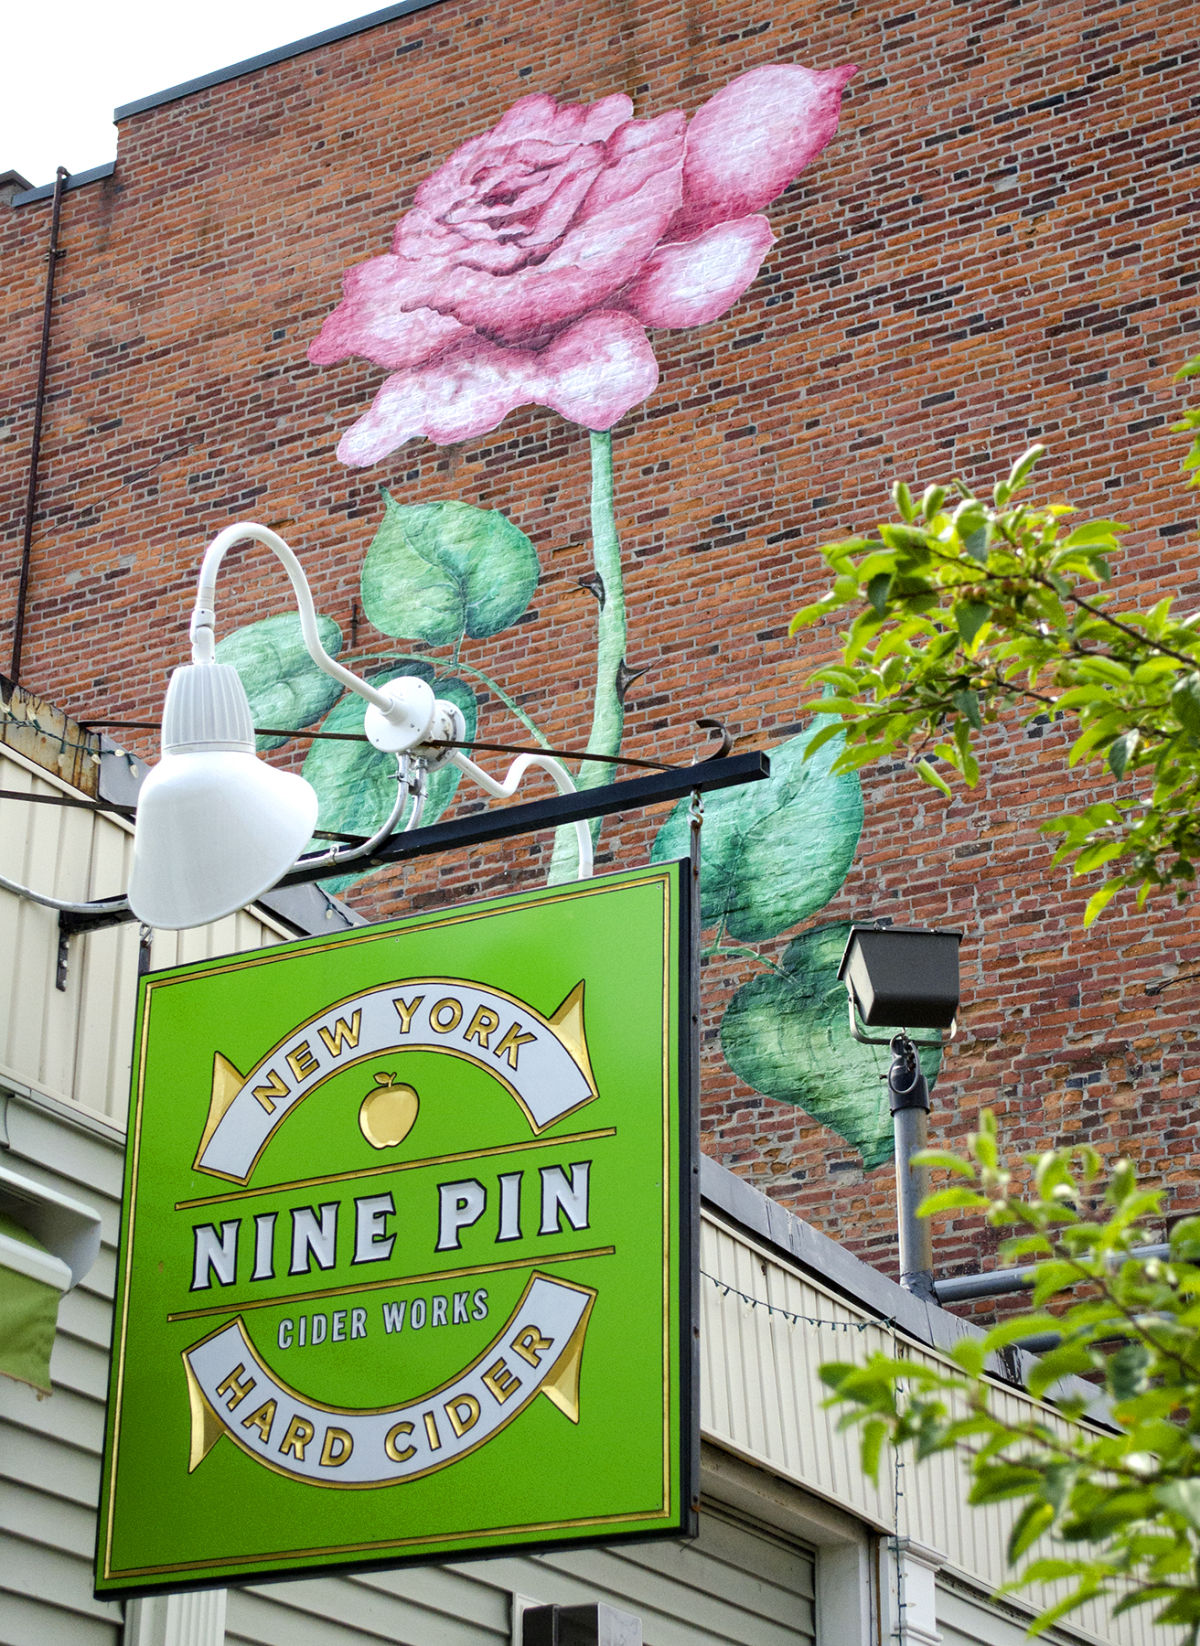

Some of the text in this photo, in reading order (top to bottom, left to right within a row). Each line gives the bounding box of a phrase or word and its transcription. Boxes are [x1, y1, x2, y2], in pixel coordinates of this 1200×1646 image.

[251, 996, 537, 1115] NEW YORK
[189, 1160, 592, 1292] NINE PIN
[277, 1288, 489, 1350] CIDER WORKS
[216, 1323, 555, 1468] HARD CIDER
